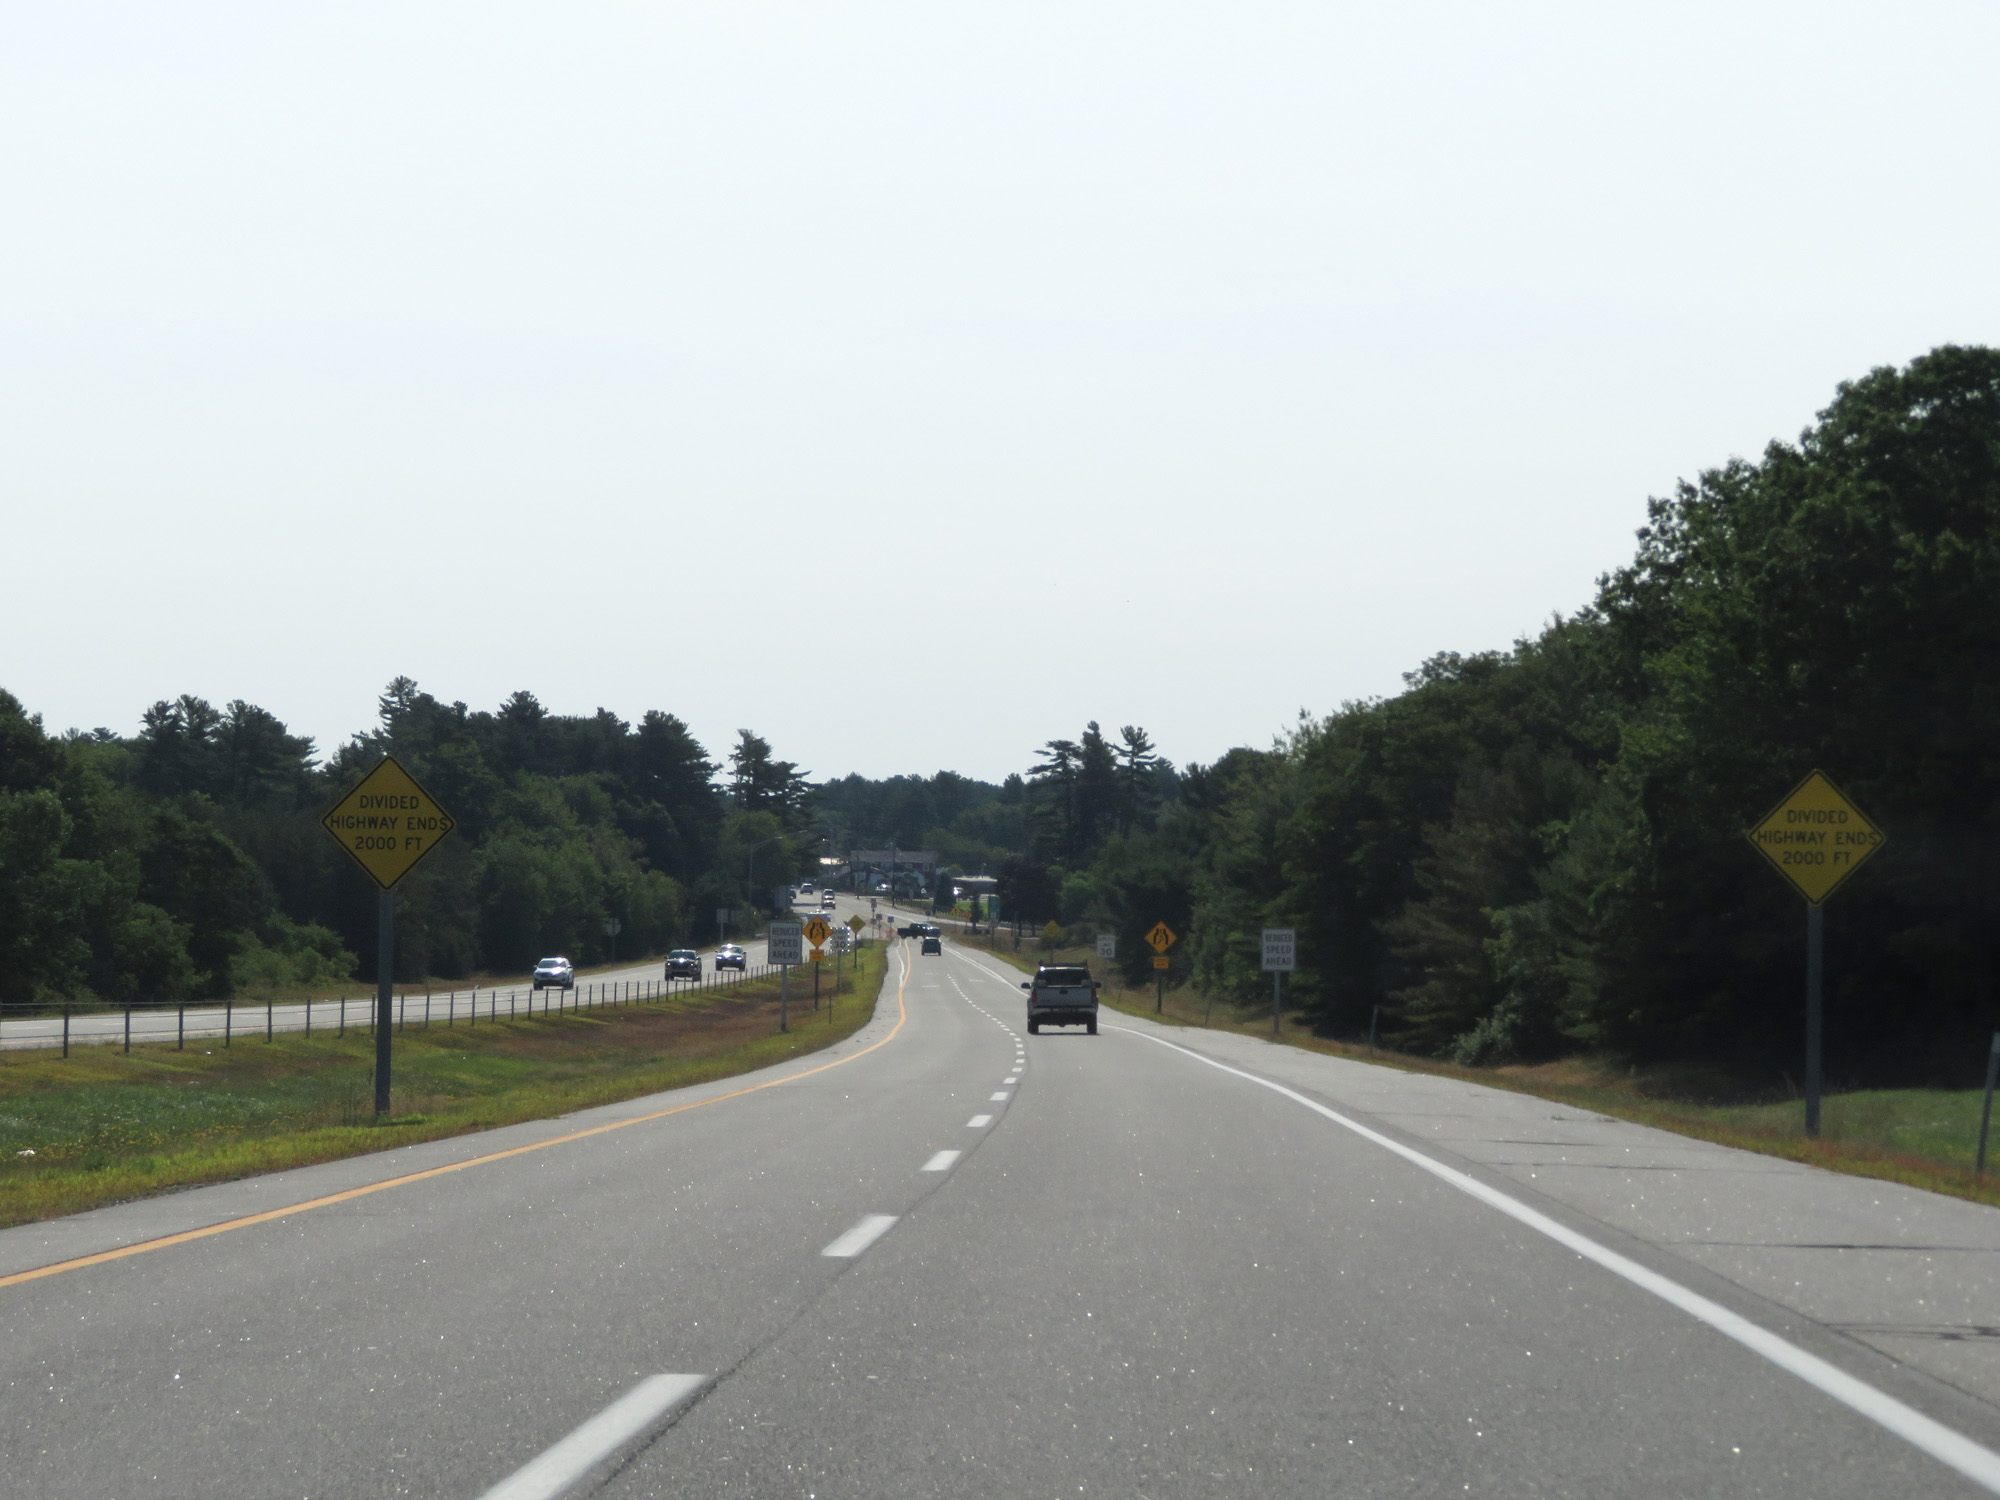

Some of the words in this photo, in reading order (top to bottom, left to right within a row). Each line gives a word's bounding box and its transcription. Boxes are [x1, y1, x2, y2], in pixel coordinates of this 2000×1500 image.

[360, 795, 419, 809] DIVIDED
[1787, 810, 1848, 824] DIVIDED
[330, 816, 398, 830] HIGHWAY
[407, 817, 448, 831] ENDS
[355, 837, 397, 850] 2000
[405, 837, 423, 851] FT
[1758, 831, 1827, 845] HIGHWAY
[1836, 832, 1878, 846] ENDS
[1782, 851, 1825, 865] 2000
[1834, 852, 1852, 866] FT
[772, 938, 798, 948] SPEED
[834, 941, 847, 949] 30
[772, 950, 799, 959] AHEAD
[1099, 948, 1113, 956] 30
[1265, 945, 1292, 954] SPEED
[1265, 957, 1292, 966] AHEAD
